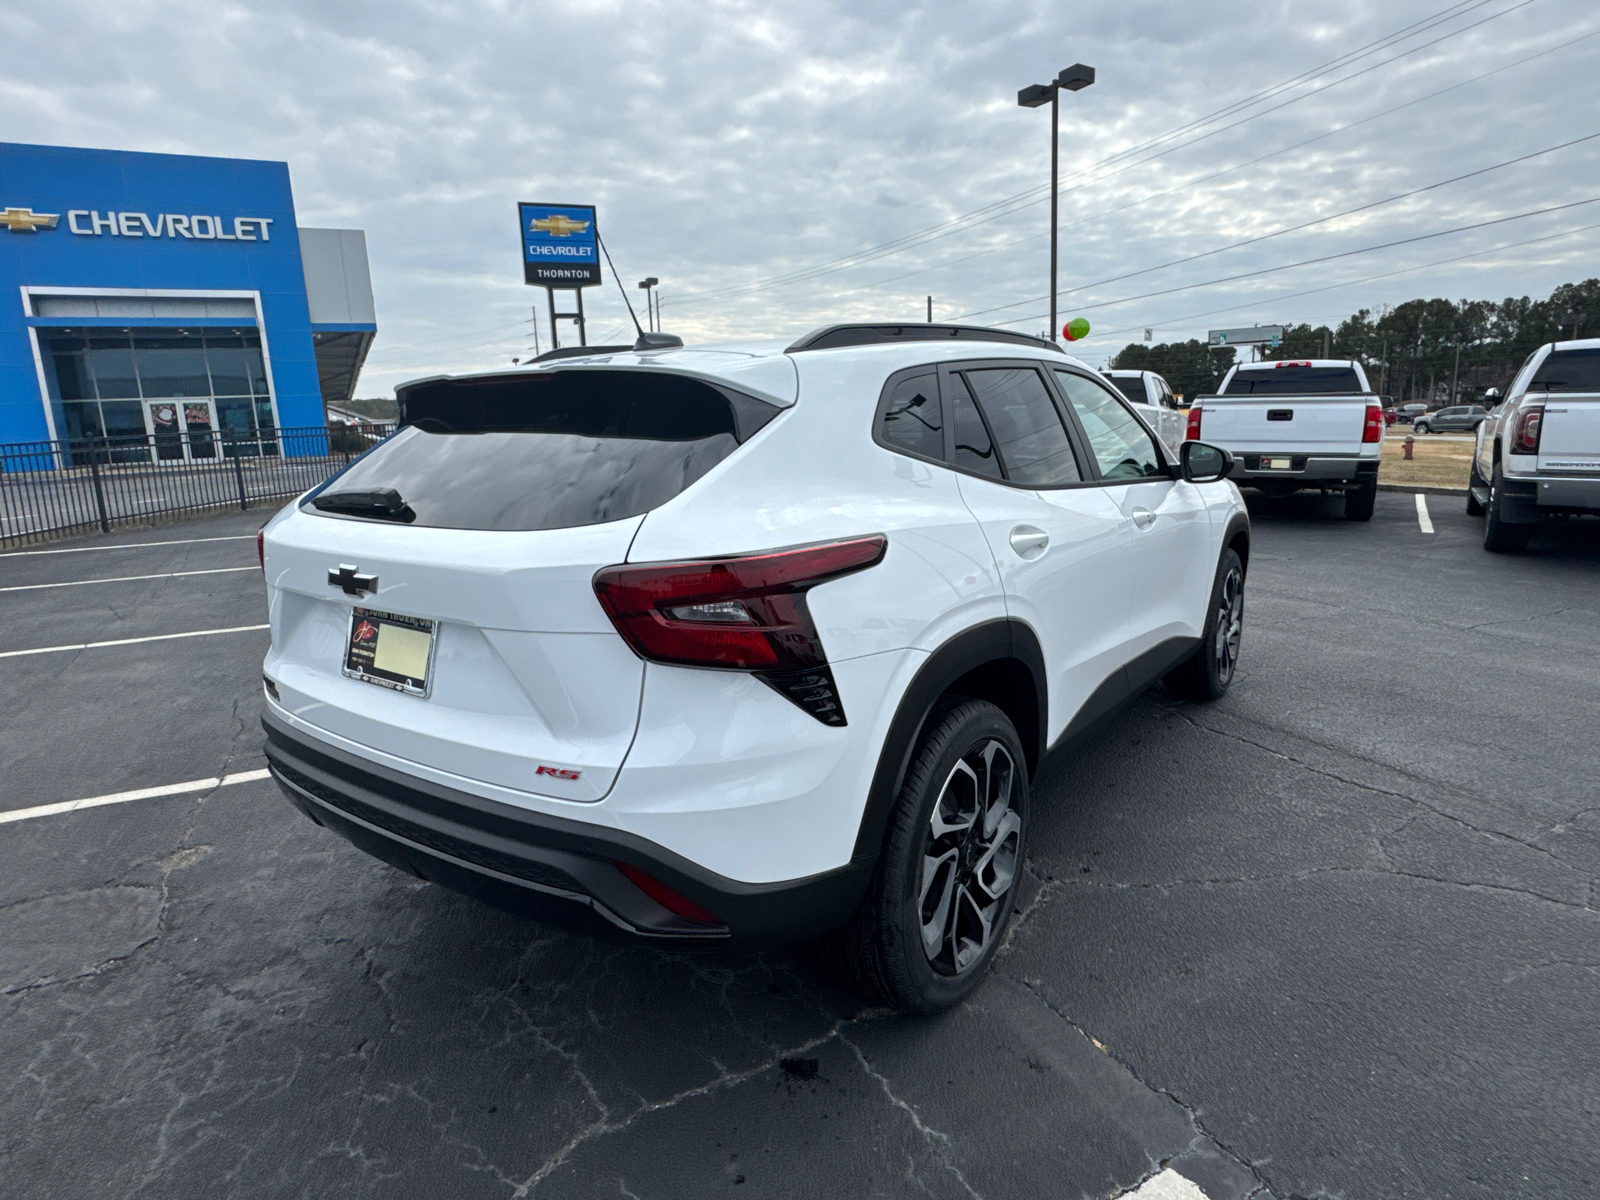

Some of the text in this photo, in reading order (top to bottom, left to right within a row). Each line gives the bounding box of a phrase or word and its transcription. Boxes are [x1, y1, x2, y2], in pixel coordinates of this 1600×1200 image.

[67, 209, 273, 241] CHEVROLET
[529, 245, 592, 256] CHEVROLET
[537, 269, 590, 279] THORNTON
[390, 613, 431, 627] THORNON
[535, 765, 582, 780] RS
